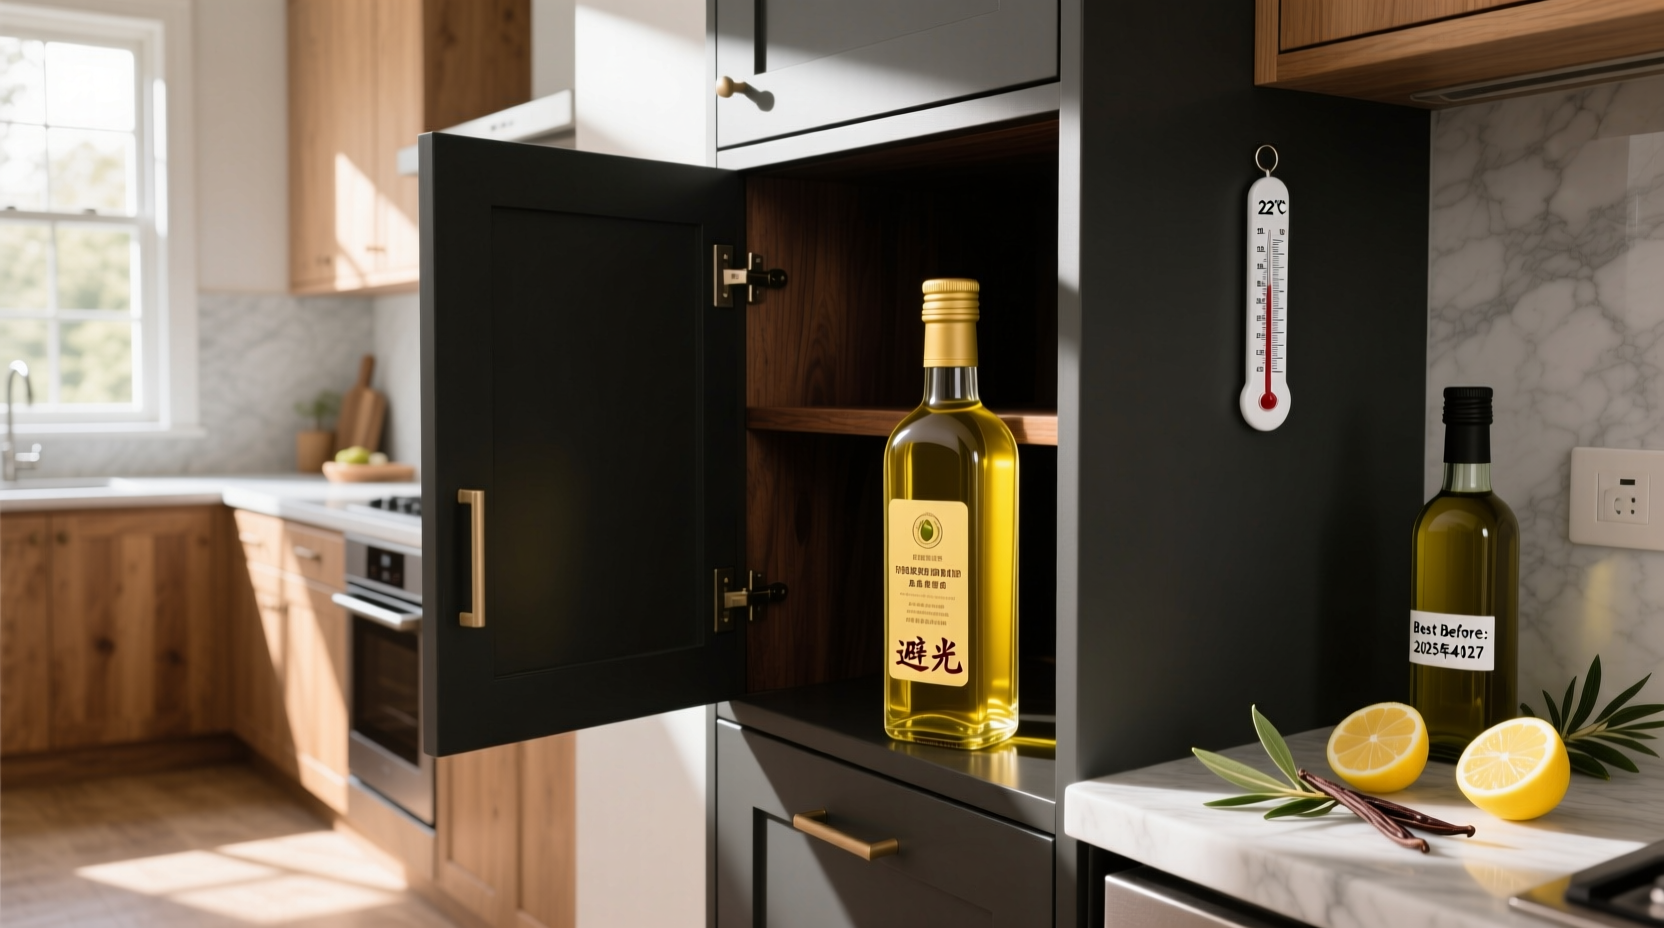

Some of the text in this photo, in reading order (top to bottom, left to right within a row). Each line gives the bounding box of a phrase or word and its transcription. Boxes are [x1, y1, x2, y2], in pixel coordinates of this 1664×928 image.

[1413, 620, 1488, 640] Best Before:
[895, 635, 963, 675] 避光
